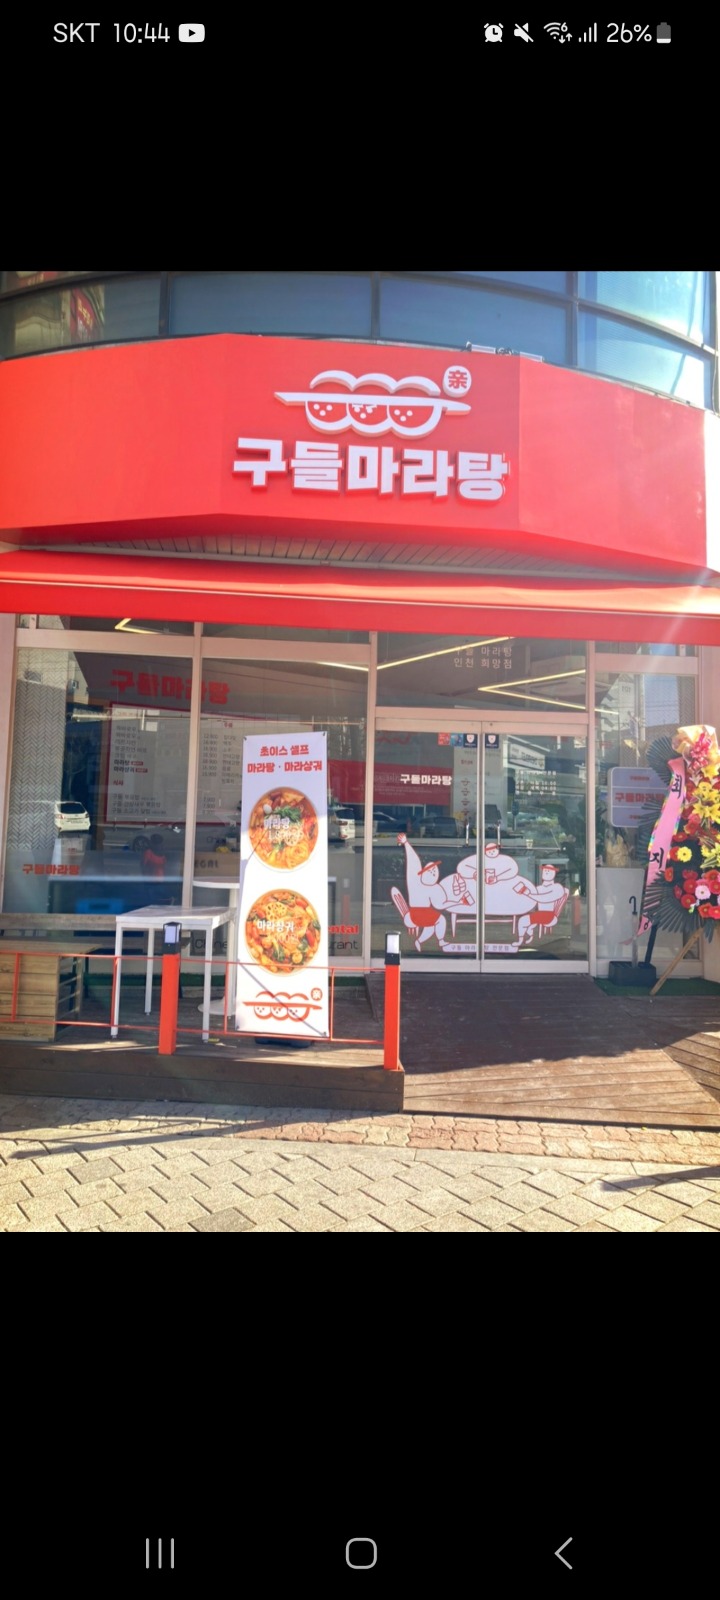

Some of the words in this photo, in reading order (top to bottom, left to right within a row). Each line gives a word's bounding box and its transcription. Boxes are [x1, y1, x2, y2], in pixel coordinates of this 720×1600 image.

[232, 437, 509, 502] 구들마라탕
[454, 657, 474, 668] 인천
[260, 746, 288, 757] 초이스
[290, 744, 309, 756] 셀프
[247, 762, 275, 773] 마라탕
[400, 773, 452, 786] 구들마라탕
